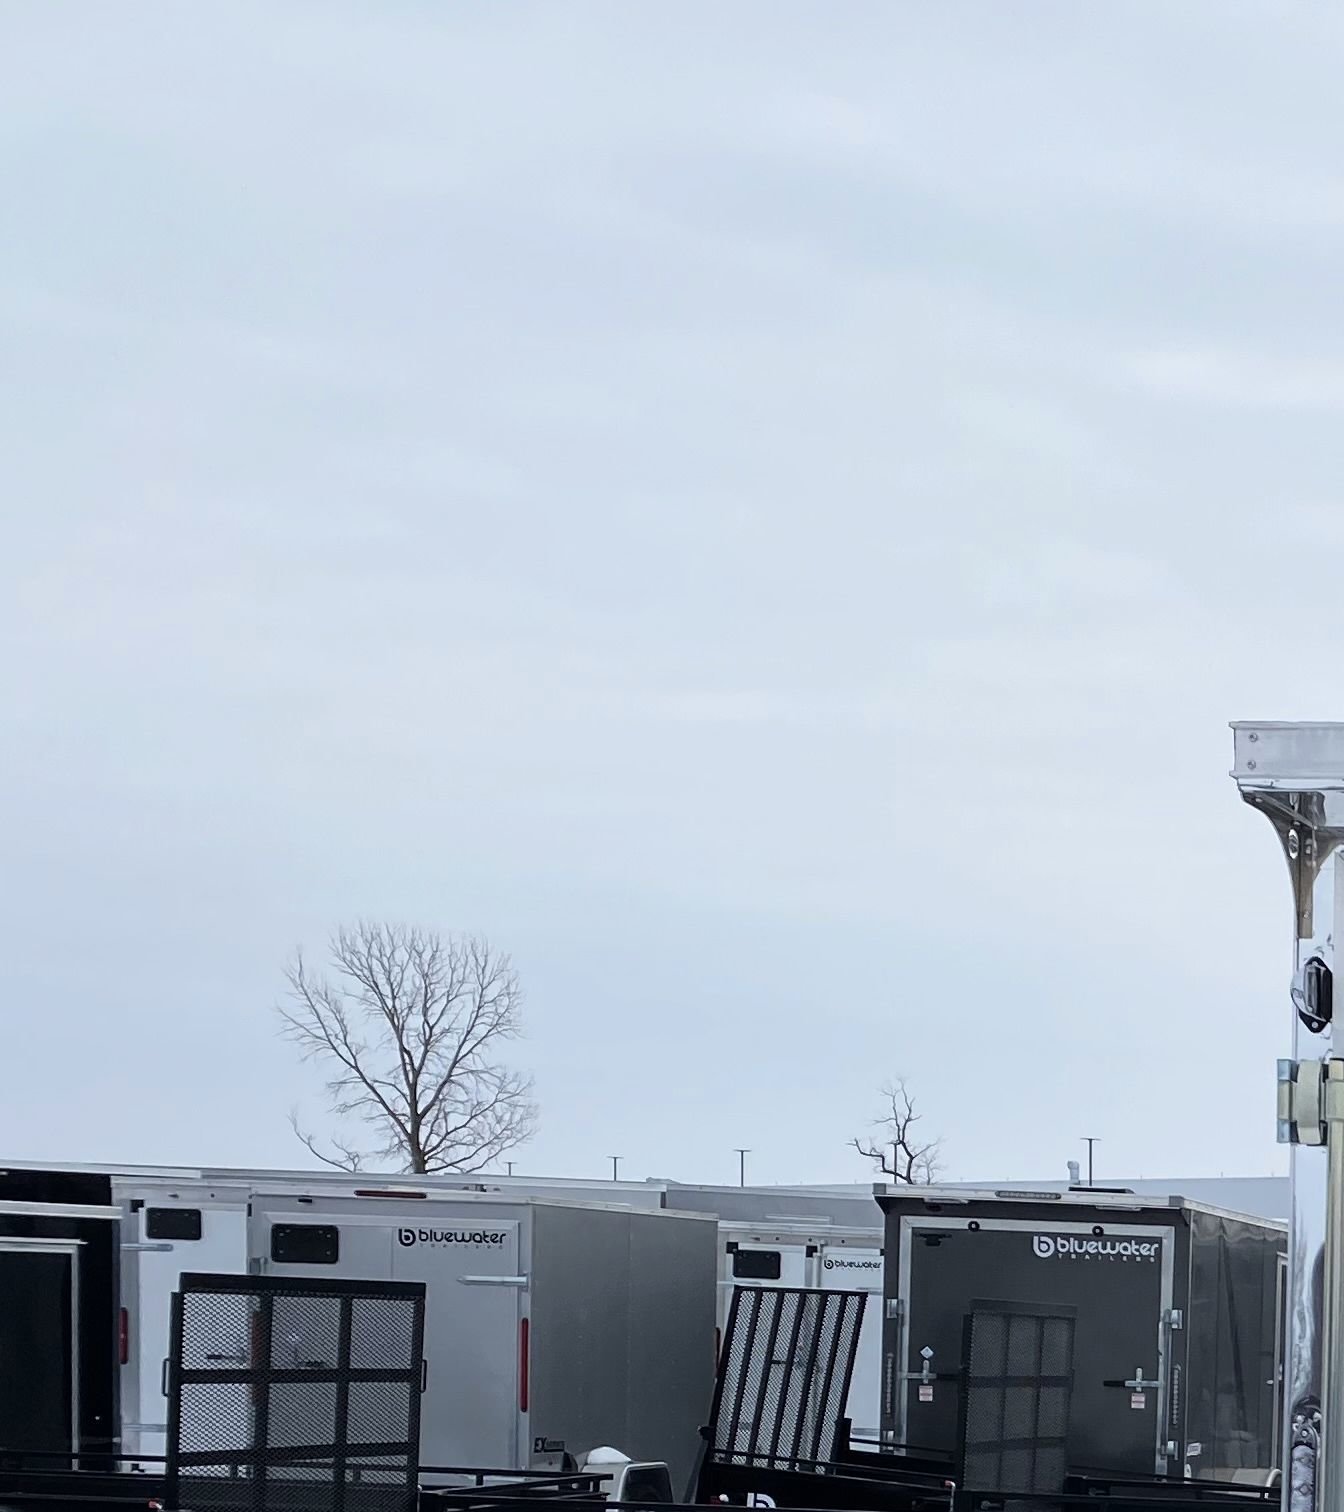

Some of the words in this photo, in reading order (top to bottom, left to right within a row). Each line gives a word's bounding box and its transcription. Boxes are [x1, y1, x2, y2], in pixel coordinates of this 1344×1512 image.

[418, 1229, 506, 1244] bluewater
[1057, 1237, 1159, 1256] bluewater
[834, 1260, 882, 1269] bluewater
